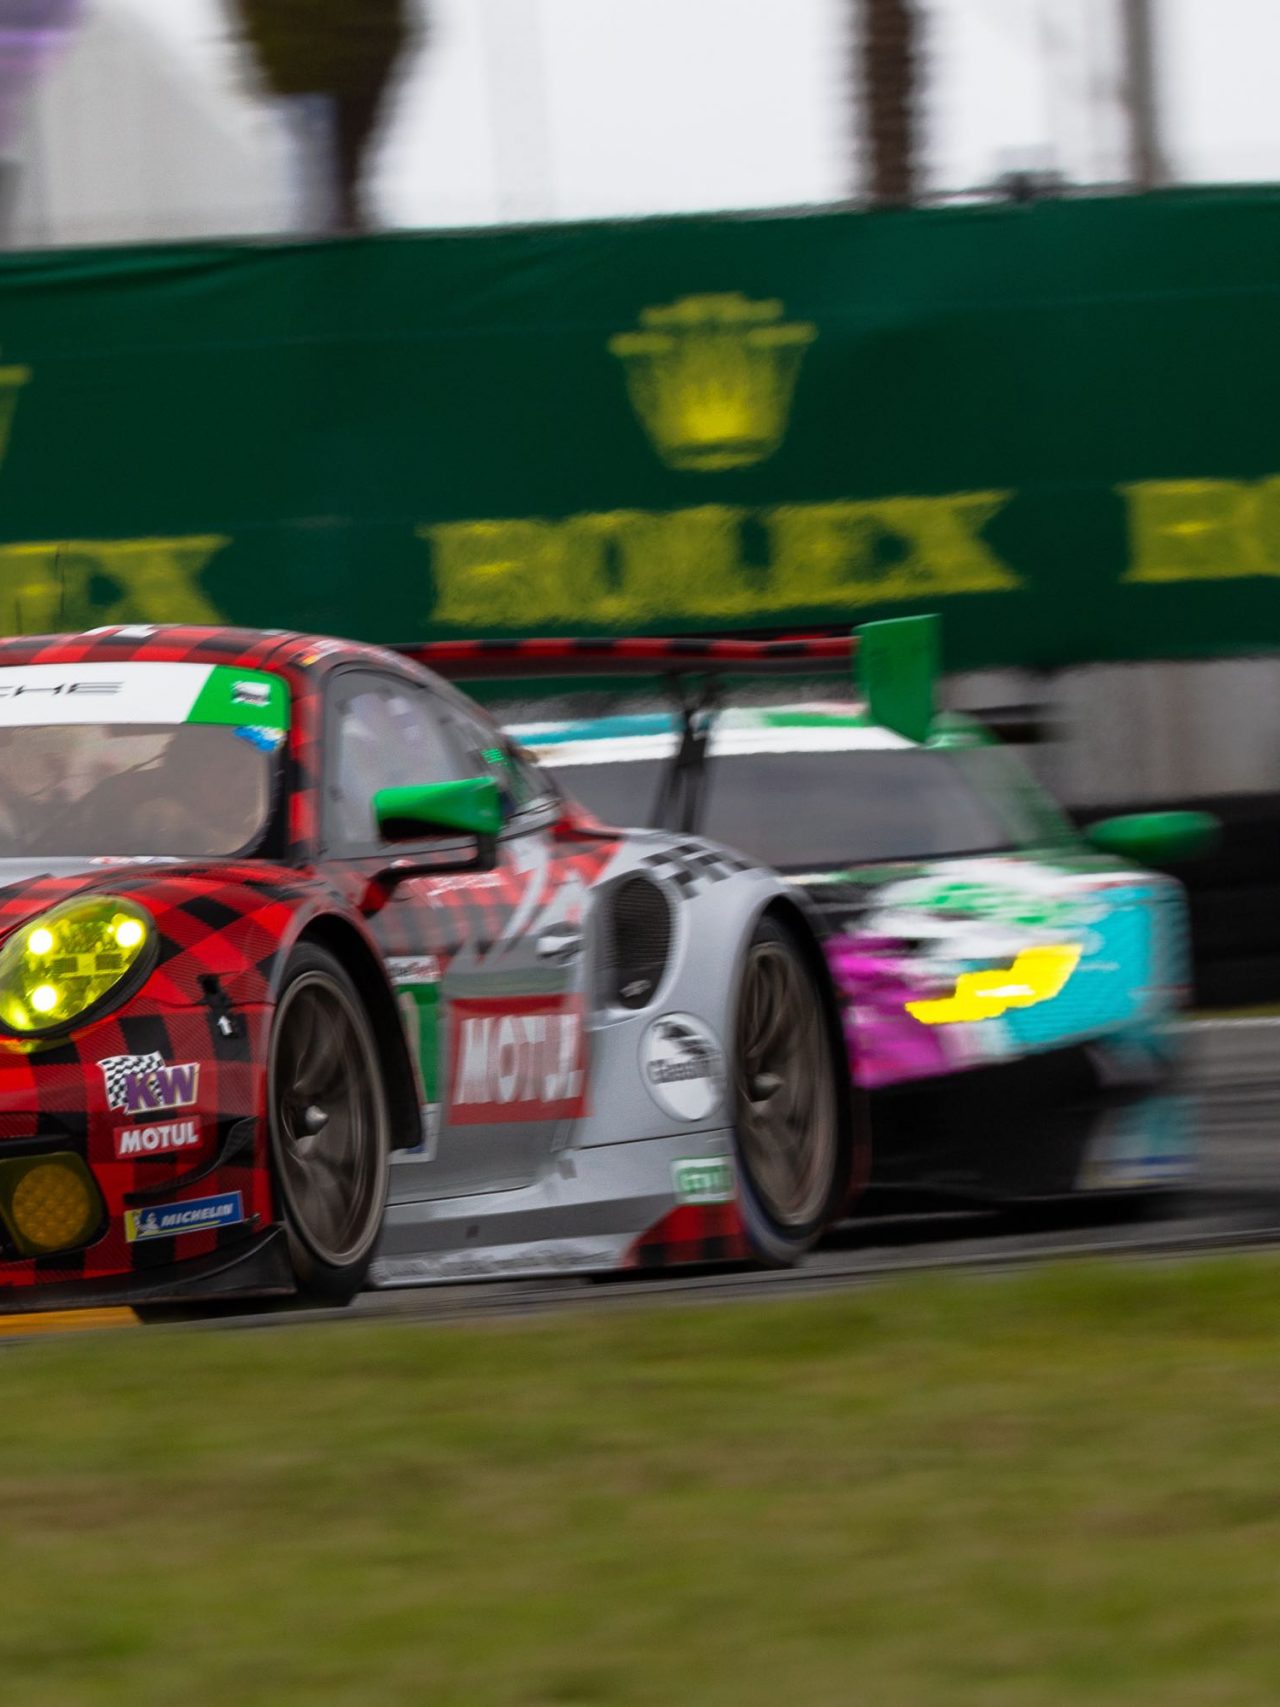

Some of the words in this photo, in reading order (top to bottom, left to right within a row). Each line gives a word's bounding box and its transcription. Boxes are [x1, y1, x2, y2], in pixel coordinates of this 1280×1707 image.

[422, 488, 1022, 628] ROLEX
[125, 1063, 198, 1112] KW
[120, 1121, 198, 1154] MOTUL
[161, 1203, 233, 1228] MICHELIN
